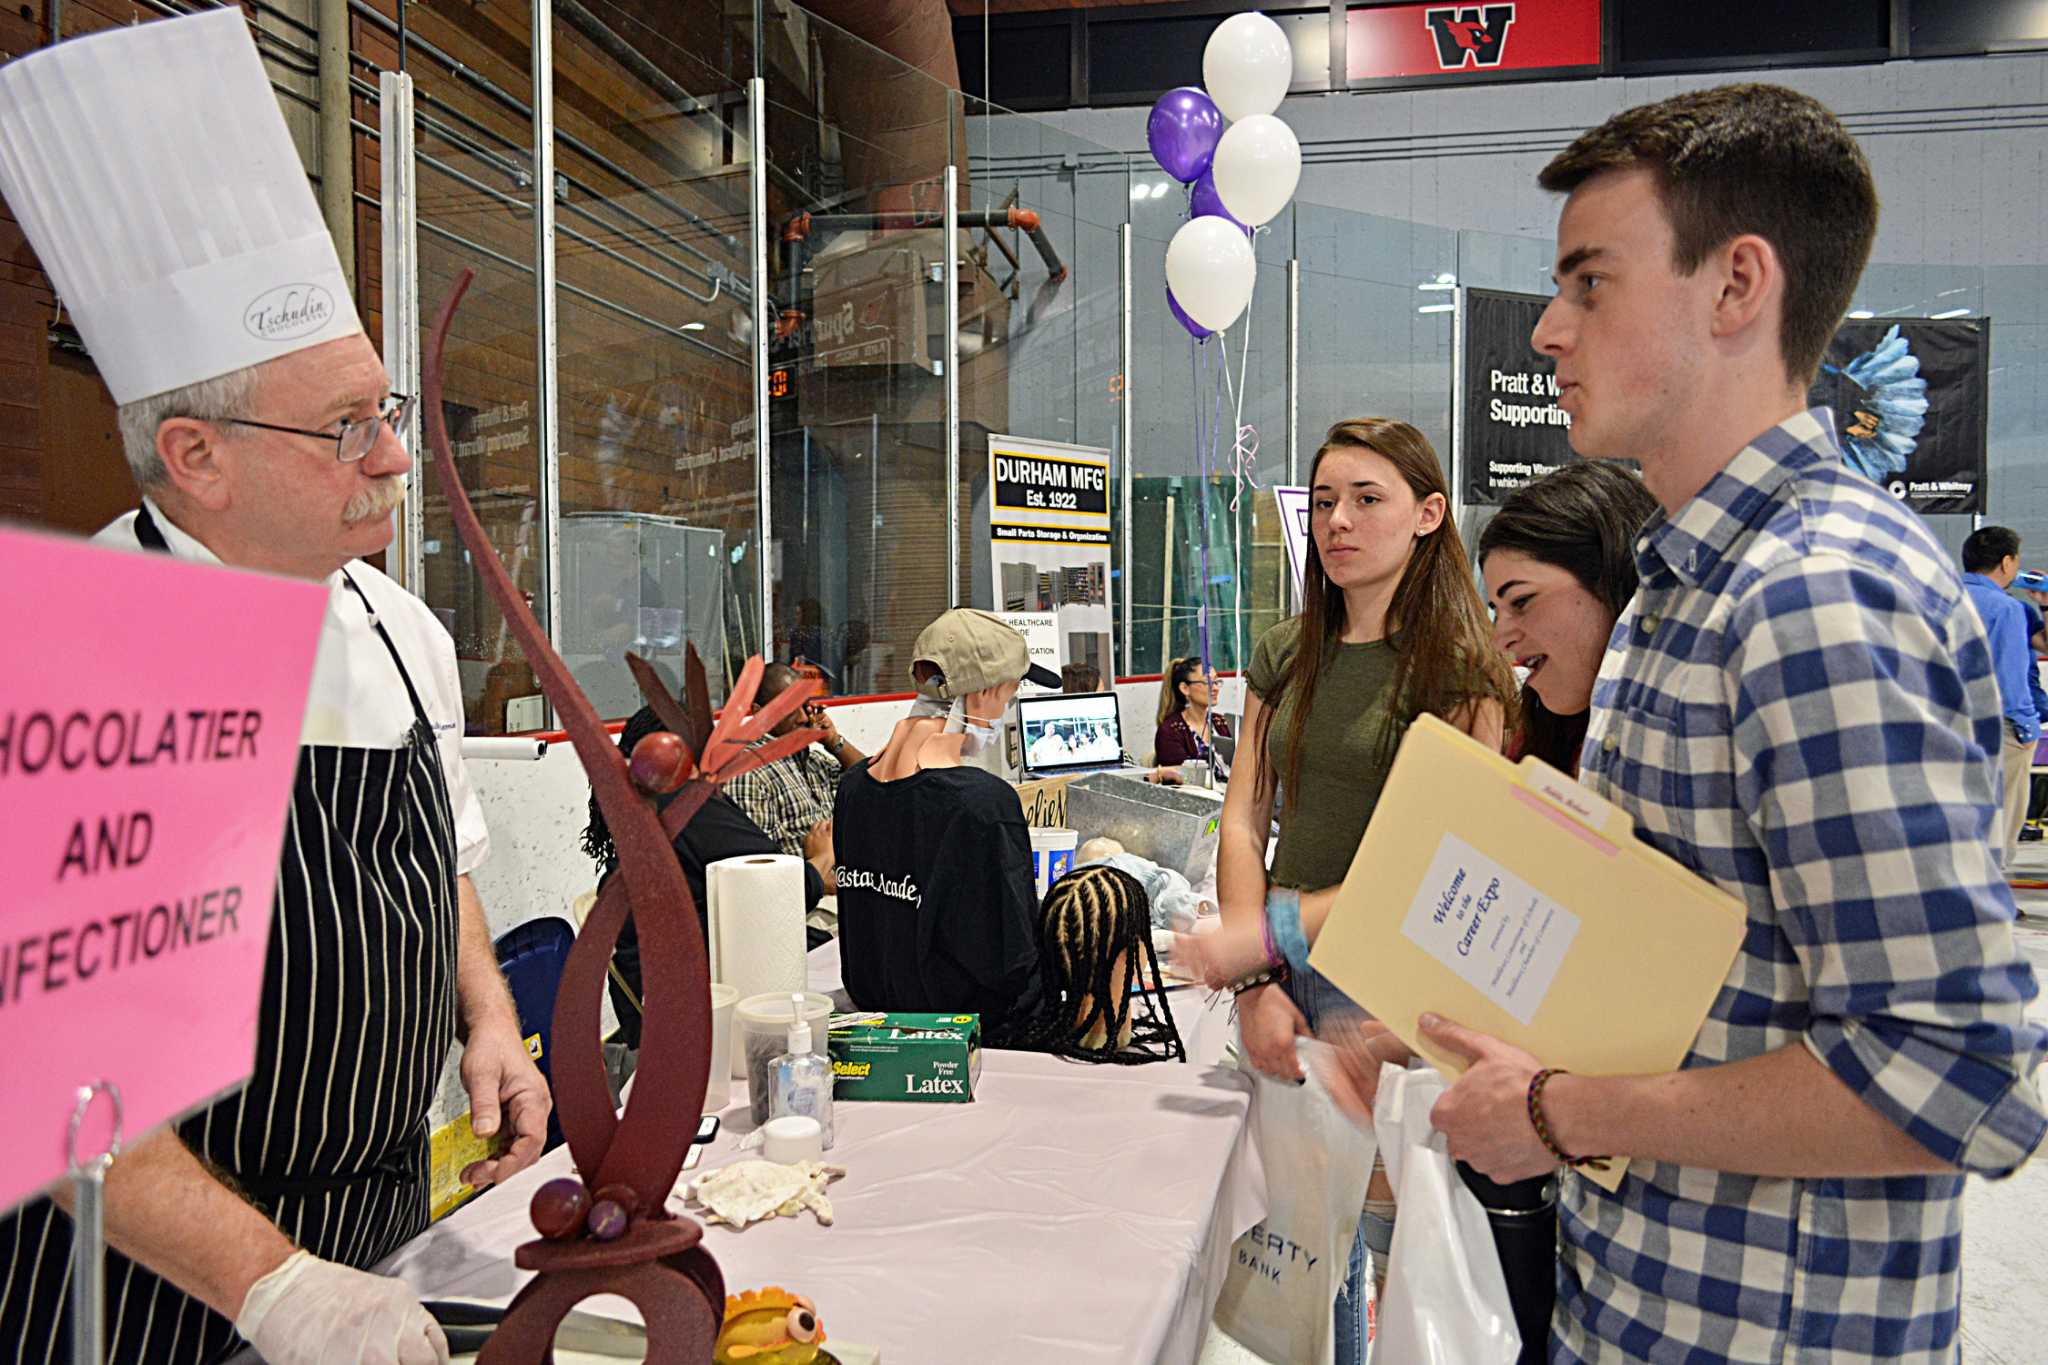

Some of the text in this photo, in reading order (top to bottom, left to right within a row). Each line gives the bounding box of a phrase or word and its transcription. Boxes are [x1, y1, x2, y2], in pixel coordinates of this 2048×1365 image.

[250, 287, 324, 330] Tschudin
[1491, 369, 1529, 394] Pratt
[1531, 373, 1545, 395] &
[996, 458, 1067, 488] DURHAM
[1489, 461, 1532, 476] Supporting
[1909, 482, 1930, 491] Pratt
[1938, 482, 1973, 493] Whitney
[1026, 489, 1077, 509] Est. 1922
[996, 527, 1107, 541] Small Parts Storage & Organization
[1009, 619, 1053, 627] HEALTHCARE
[57, 811, 154, 882] AND
[1433, 868, 1466, 924] Welcome
[1456, 894, 1472, 920] to the
[1457, 877, 1500, 956] Career Expo
[888, 1029, 965, 1040] Latex
[833, 1061, 871, 1076] Select
[933, 1061, 959, 1069] Powder
[938, 1068, 954, 1076] Free
[905, 1074, 964, 1094] Latex
[1246, 1225, 1318, 1272] ERTY
[1238, 1250, 1281, 1285] BANK
